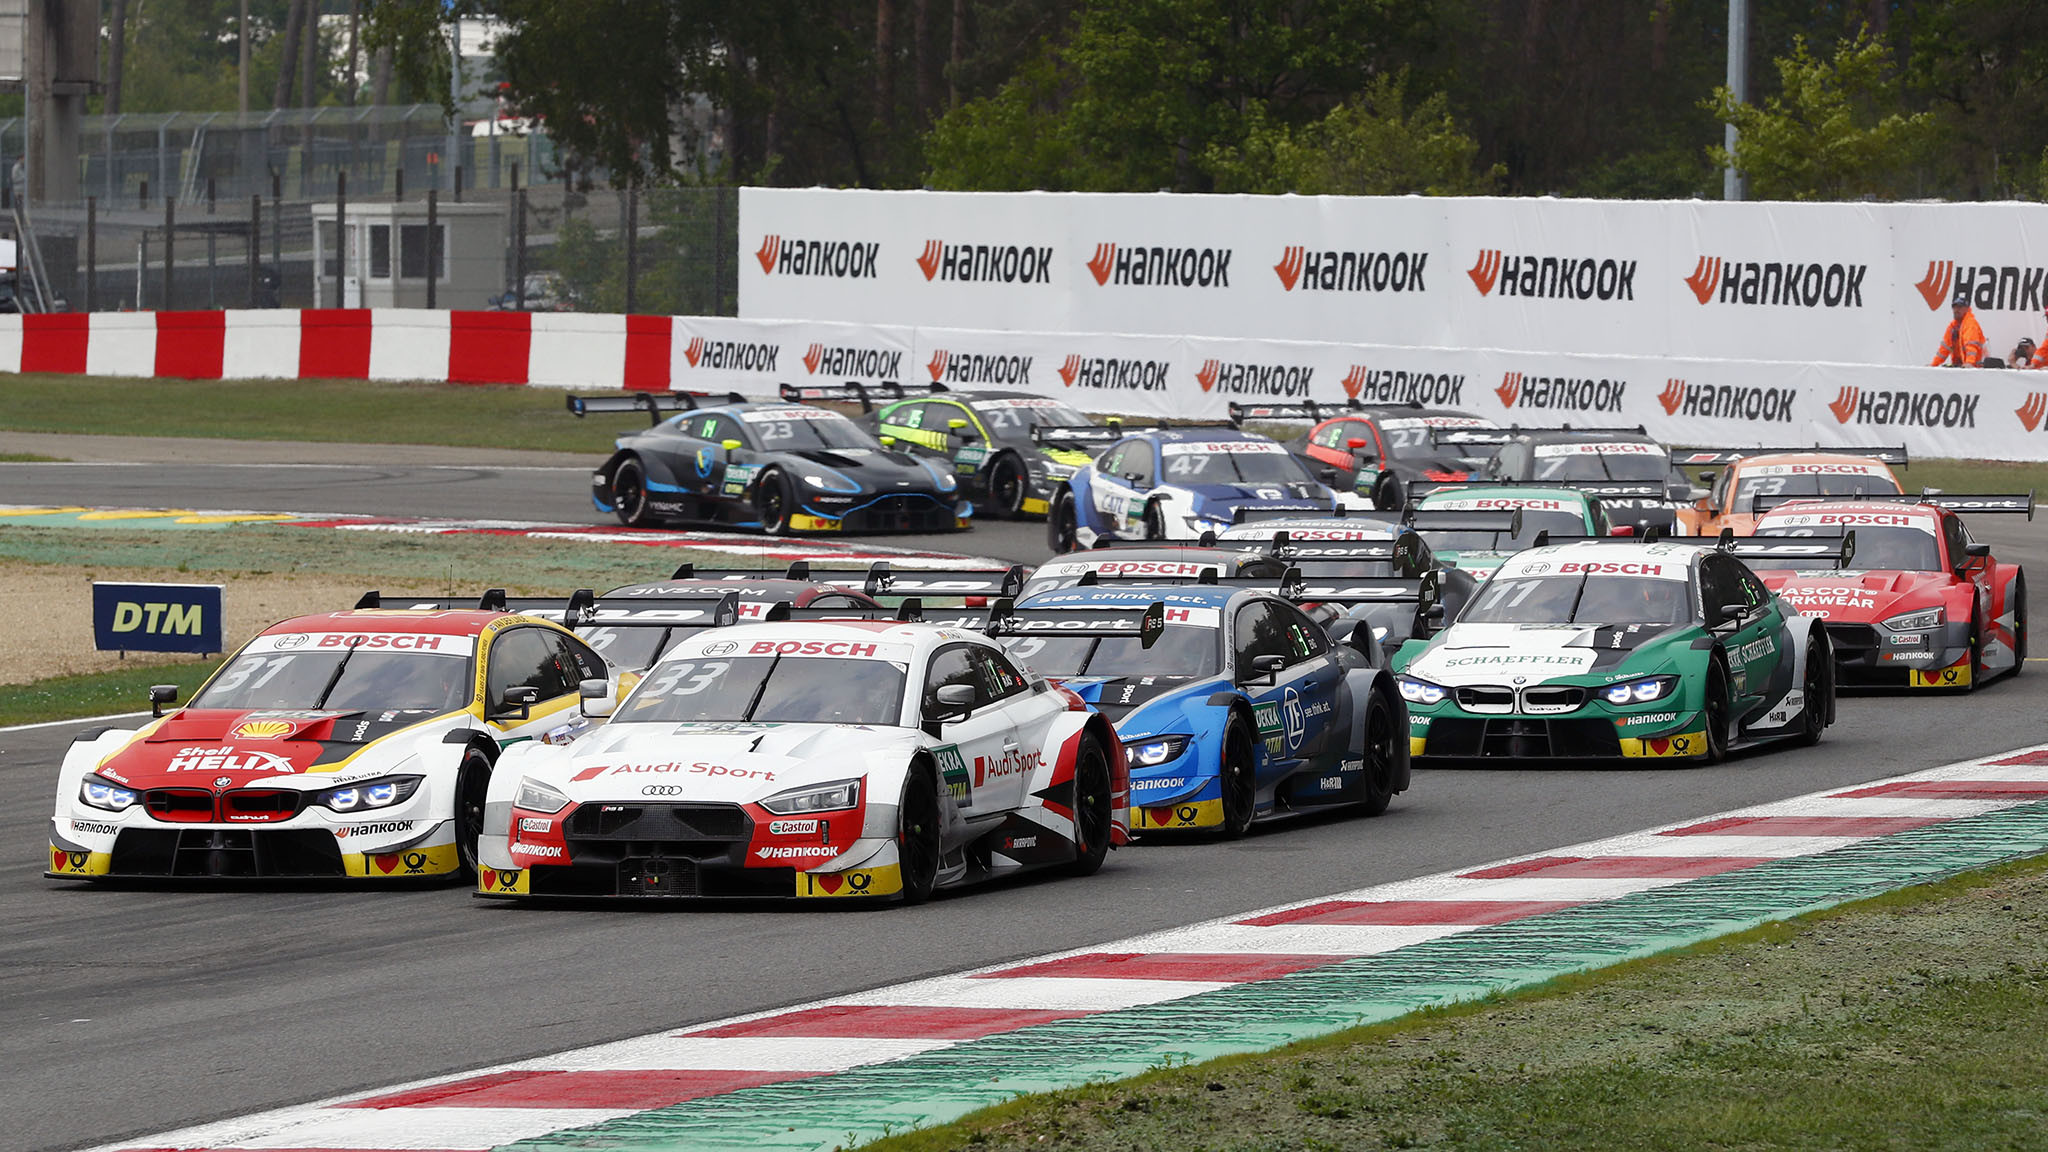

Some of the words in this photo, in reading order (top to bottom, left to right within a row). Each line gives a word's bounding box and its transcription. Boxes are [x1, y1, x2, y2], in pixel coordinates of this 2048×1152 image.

[1952, 266, 2048, 312] HANK
[987, 410, 1021, 428] 21
[760, 422, 794, 440] 23
[1391, 429, 1428, 449] 27
[1580, 445, 1648, 453] BOSCH
[1168, 456, 1211, 475] 47
[1539, 457, 1567, 480] 7
[1791, 465, 1868, 474] BOSCH
[1744, 478, 1787, 496] 53
[1475, 500, 1560, 510] BOSCH
[1819, 515, 1909, 525] BOSCH
[1273, 531, 1363, 541] OSCH
[1098, 563, 1198, 575] BOSCH
[1559, 562, 1662, 576] BOSCH
[1483, 579, 1544, 610] 11
[1781, 596, 1875, 609] ORKWEAR
[112, 601, 203, 636] DTM
[317, 634, 442, 650] BOSCH
[1898, 635, 1919, 644] Castrol
[748, 641, 878, 657] BOSCH
[1445, 655, 1584, 668] SCHAEFFLER
[212, 656, 297, 694] 31
[639, 662, 730, 698] 33
[1256, 707, 1280, 728] DEKRA
[176, 746, 235, 757] Shell
[166, 751, 296, 773] HELIX
[937, 750, 963, 772] EKRA
[988, 754, 1013, 778] Audi
[1013, 748, 1046, 778] Sport
[610, 762, 682, 775] Audi
[689, 763, 775, 782] Sport
[528, 820, 549, 831] Castrol
[781, 822, 815, 833] Castrol
